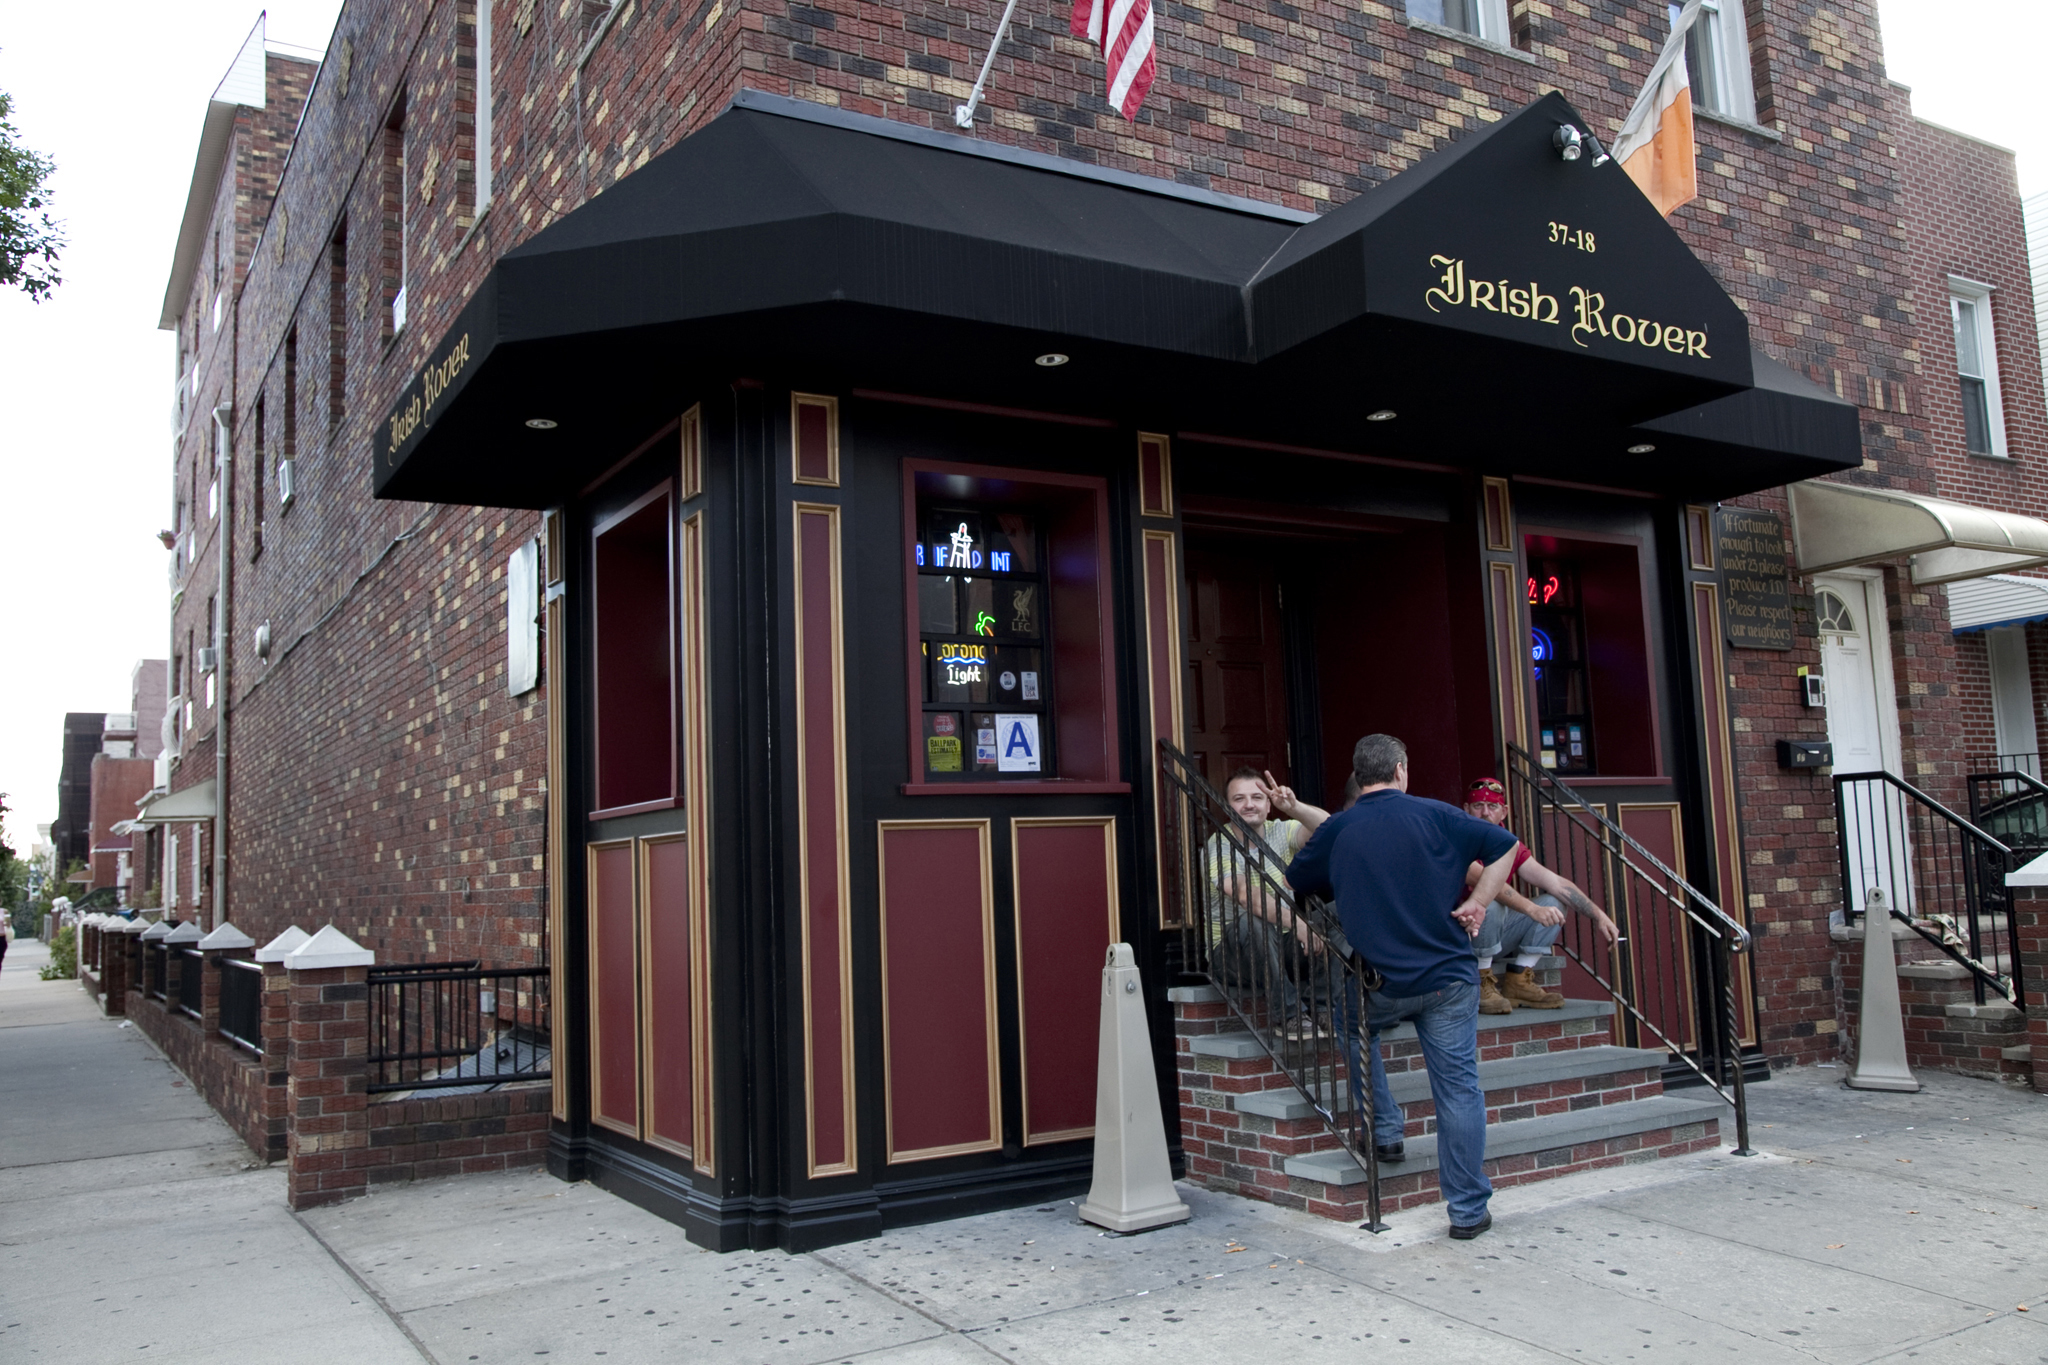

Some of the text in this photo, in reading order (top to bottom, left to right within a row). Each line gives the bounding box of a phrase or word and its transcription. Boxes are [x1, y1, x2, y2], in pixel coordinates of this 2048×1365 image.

[1548, 221, 1596, 253] 37-18
[1425, 254, 1711, 359] Irish Rover
[387, 332, 470, 466] Irish Rover
[1733, 515, 1779, 536] fortunate
[1720, 536, 1785, 557] enough to look
[1723, 555, 1747, 571] under
[1758, 559, 1785, 577] please
[1728, 576, 1768, 596] produce
[1725, 597, 1757, 617] Please
[1731, 622, 1791, 644] our neighbors
[946, 664, 981, 686] Light
[930, 739, 957, 747] BALLPARK
[1005, 721, 1033, 758] A
